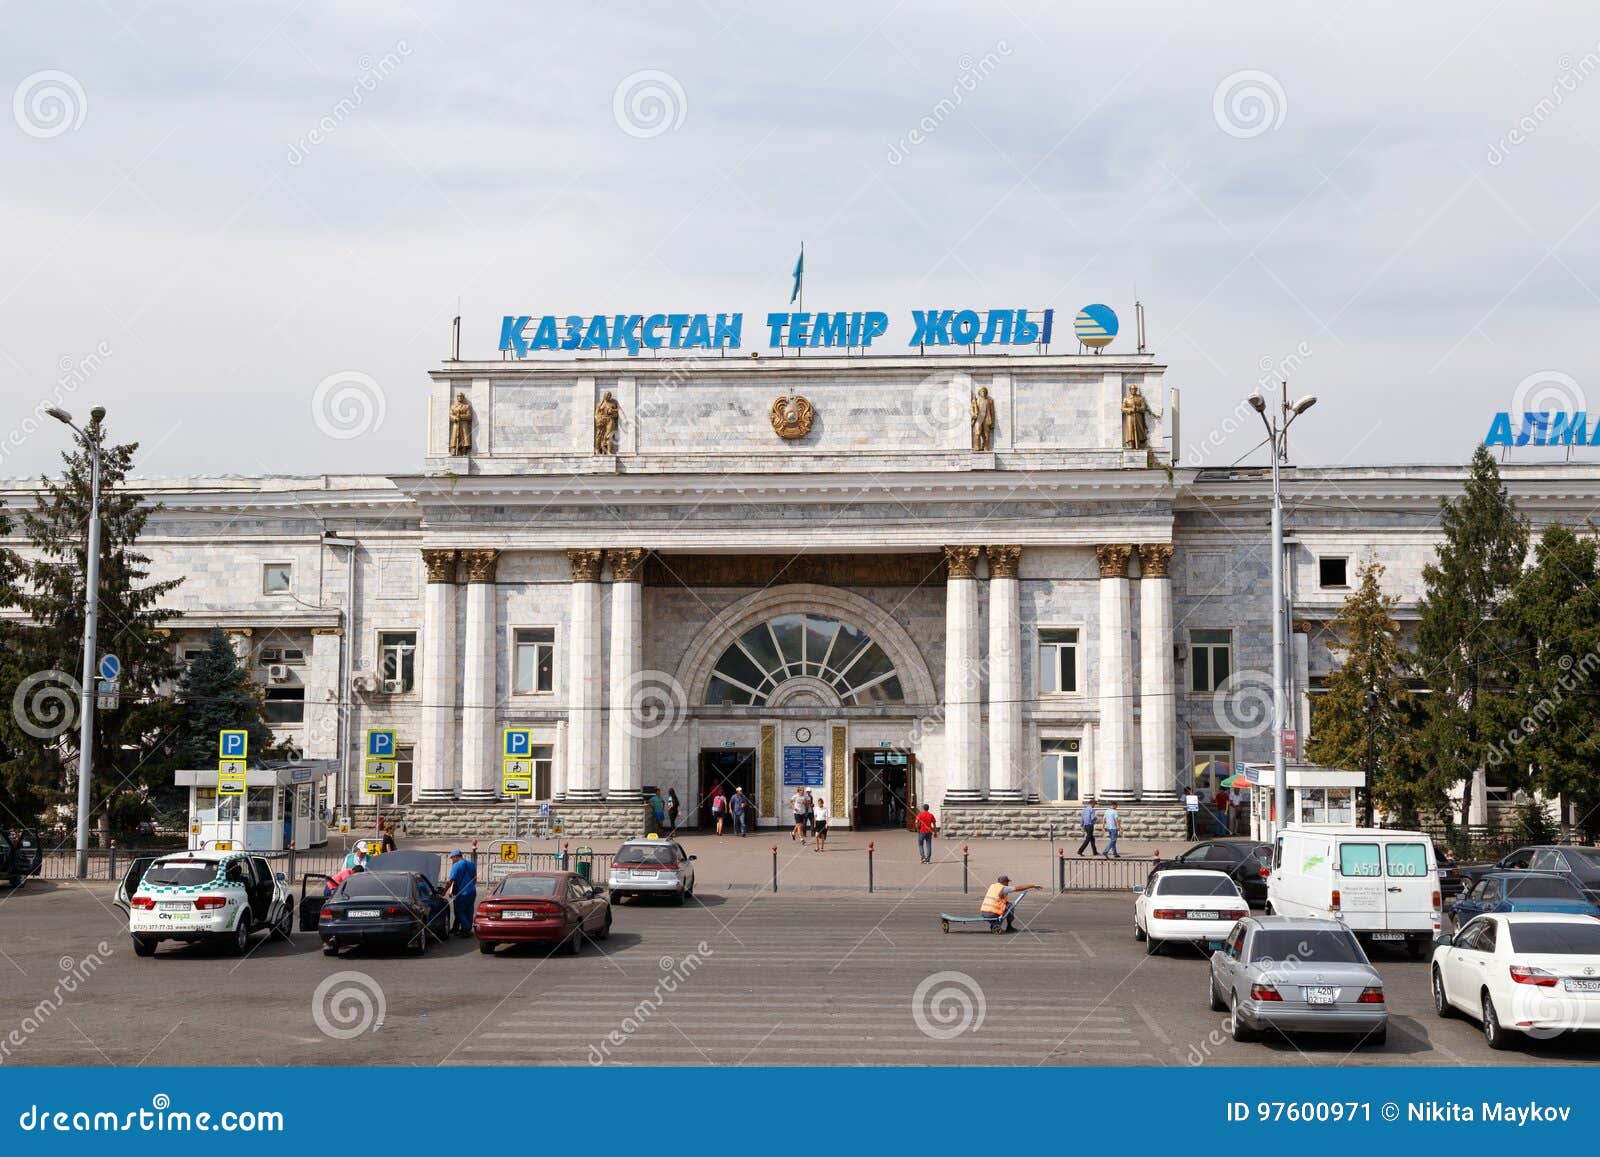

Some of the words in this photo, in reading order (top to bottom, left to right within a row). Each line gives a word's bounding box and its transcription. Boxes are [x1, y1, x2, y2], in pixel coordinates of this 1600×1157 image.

[499, 314, 743, 356] ҚАЗАҚСТАН
[766, 311, 889, 348] ТЕМІР
[909, 309, 1055, 347] ЖОЛЫ
[228, 734, 241, 752] P
[375, 734, 389, 753] P
[512, 733, 525, 752] P
